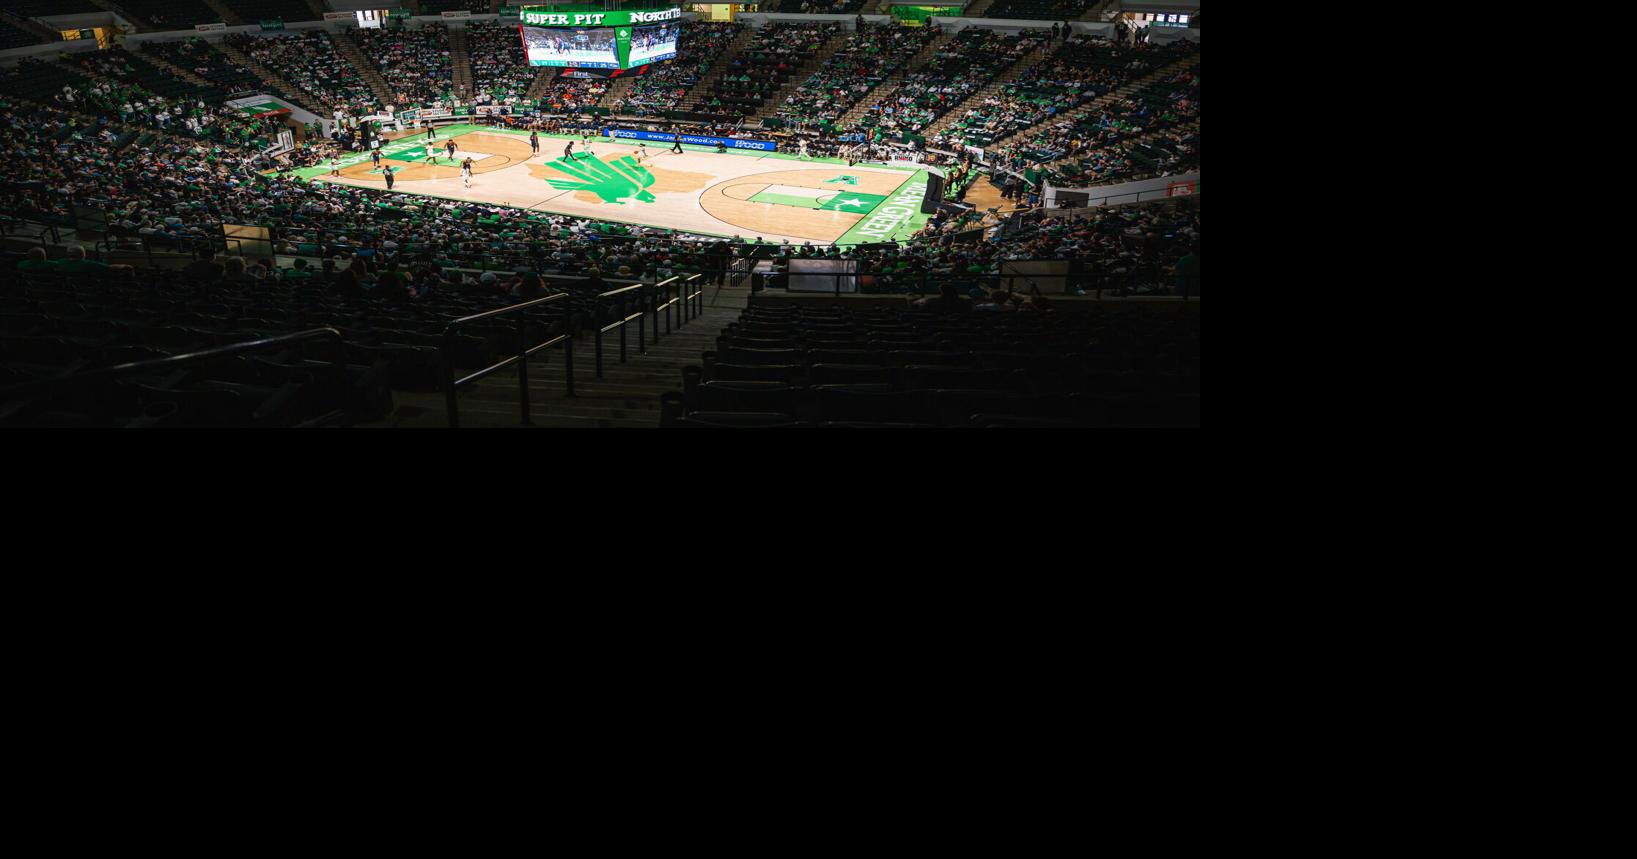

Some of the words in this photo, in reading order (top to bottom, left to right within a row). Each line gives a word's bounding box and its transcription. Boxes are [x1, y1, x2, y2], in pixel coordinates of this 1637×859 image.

[526, 13, 569, 25] SUPER
[574, 14, 605, 25] PIT
[629, 10, 672, 23] NORTH
[856, 206, 915, 239] GREEN
